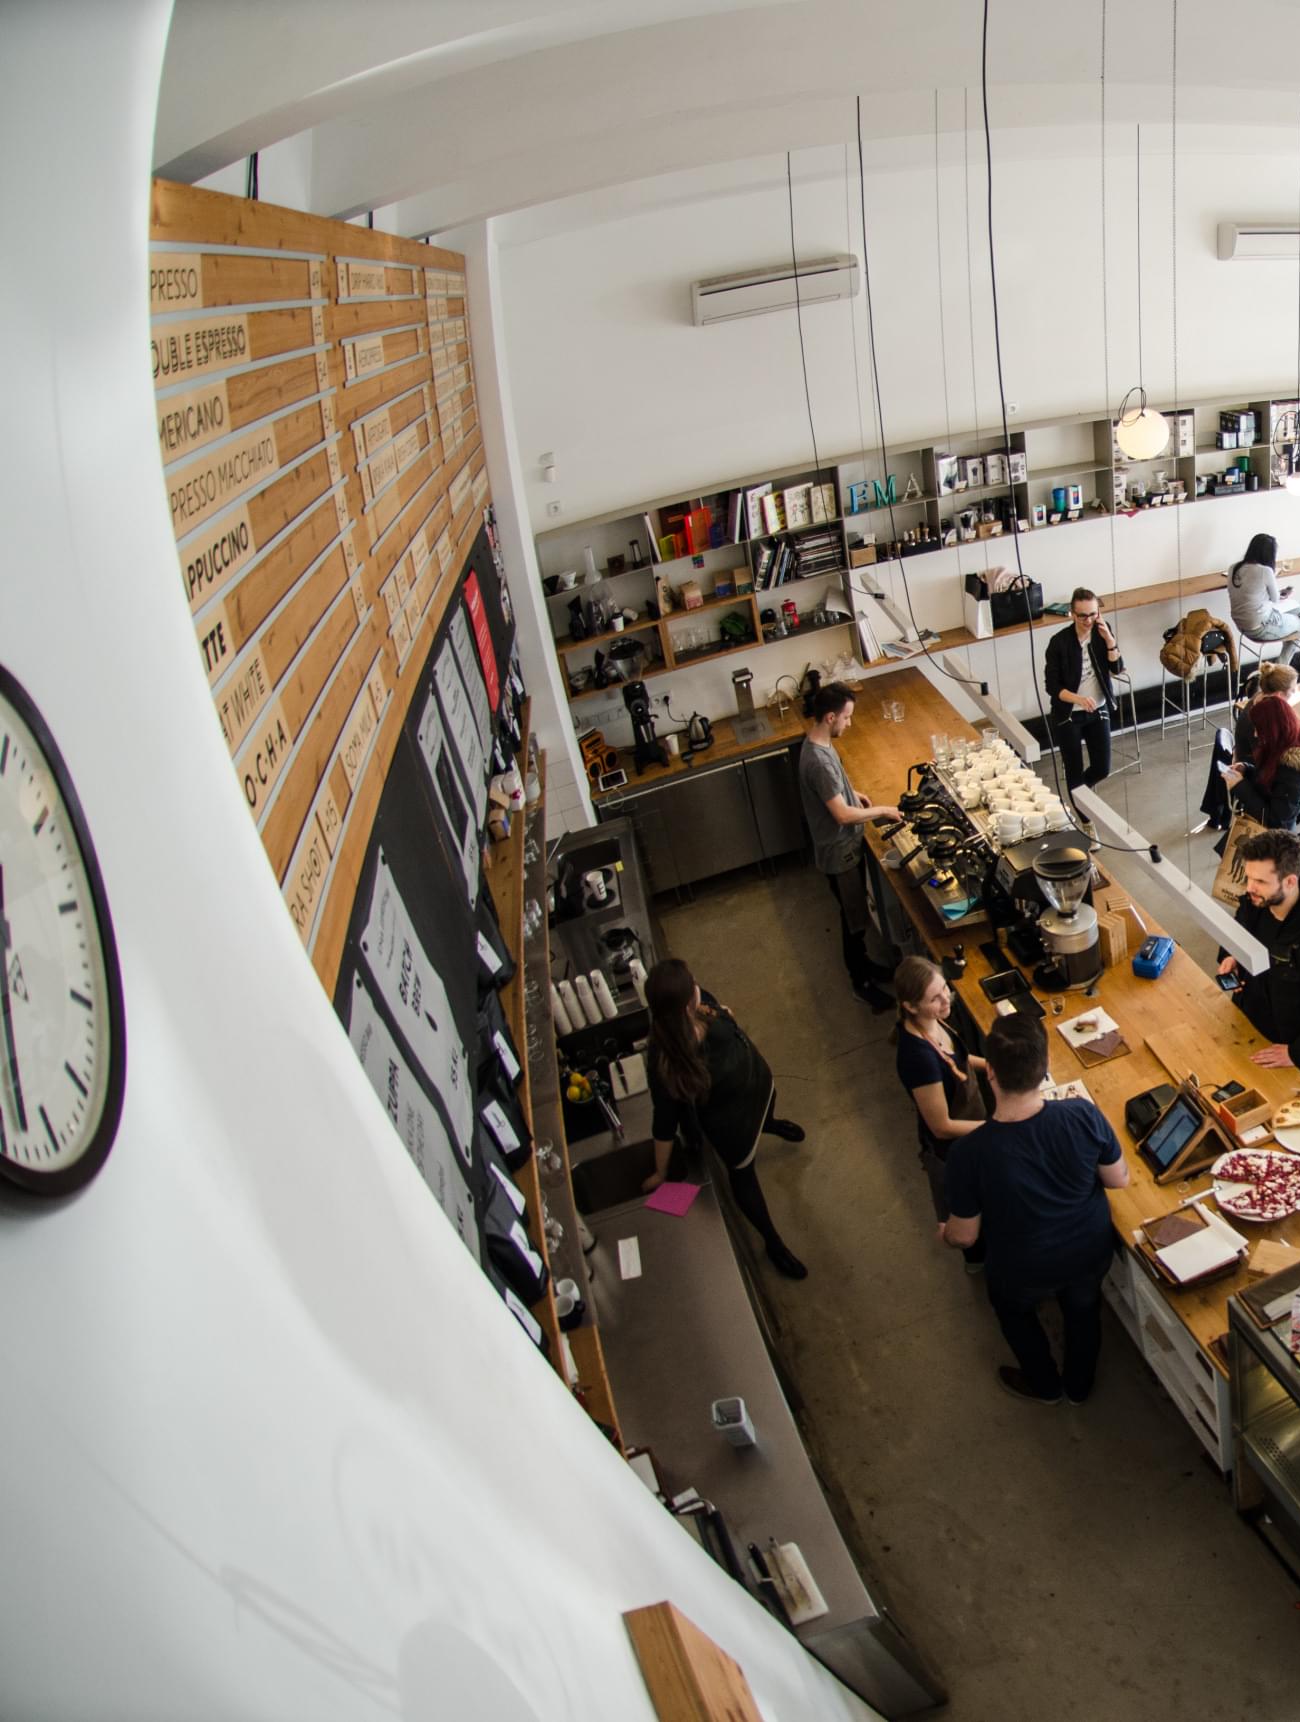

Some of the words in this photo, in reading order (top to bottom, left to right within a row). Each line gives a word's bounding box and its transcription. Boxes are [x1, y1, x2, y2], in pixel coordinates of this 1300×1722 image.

[194, 323, 246, 367] ESPRESSO
[218, 437, 274, 494] MACCHIATO
[847, 472, 924, 514] EMA
[230, 657, 265, 727] WHITE
[300, 837, 325, 904] SHOT
